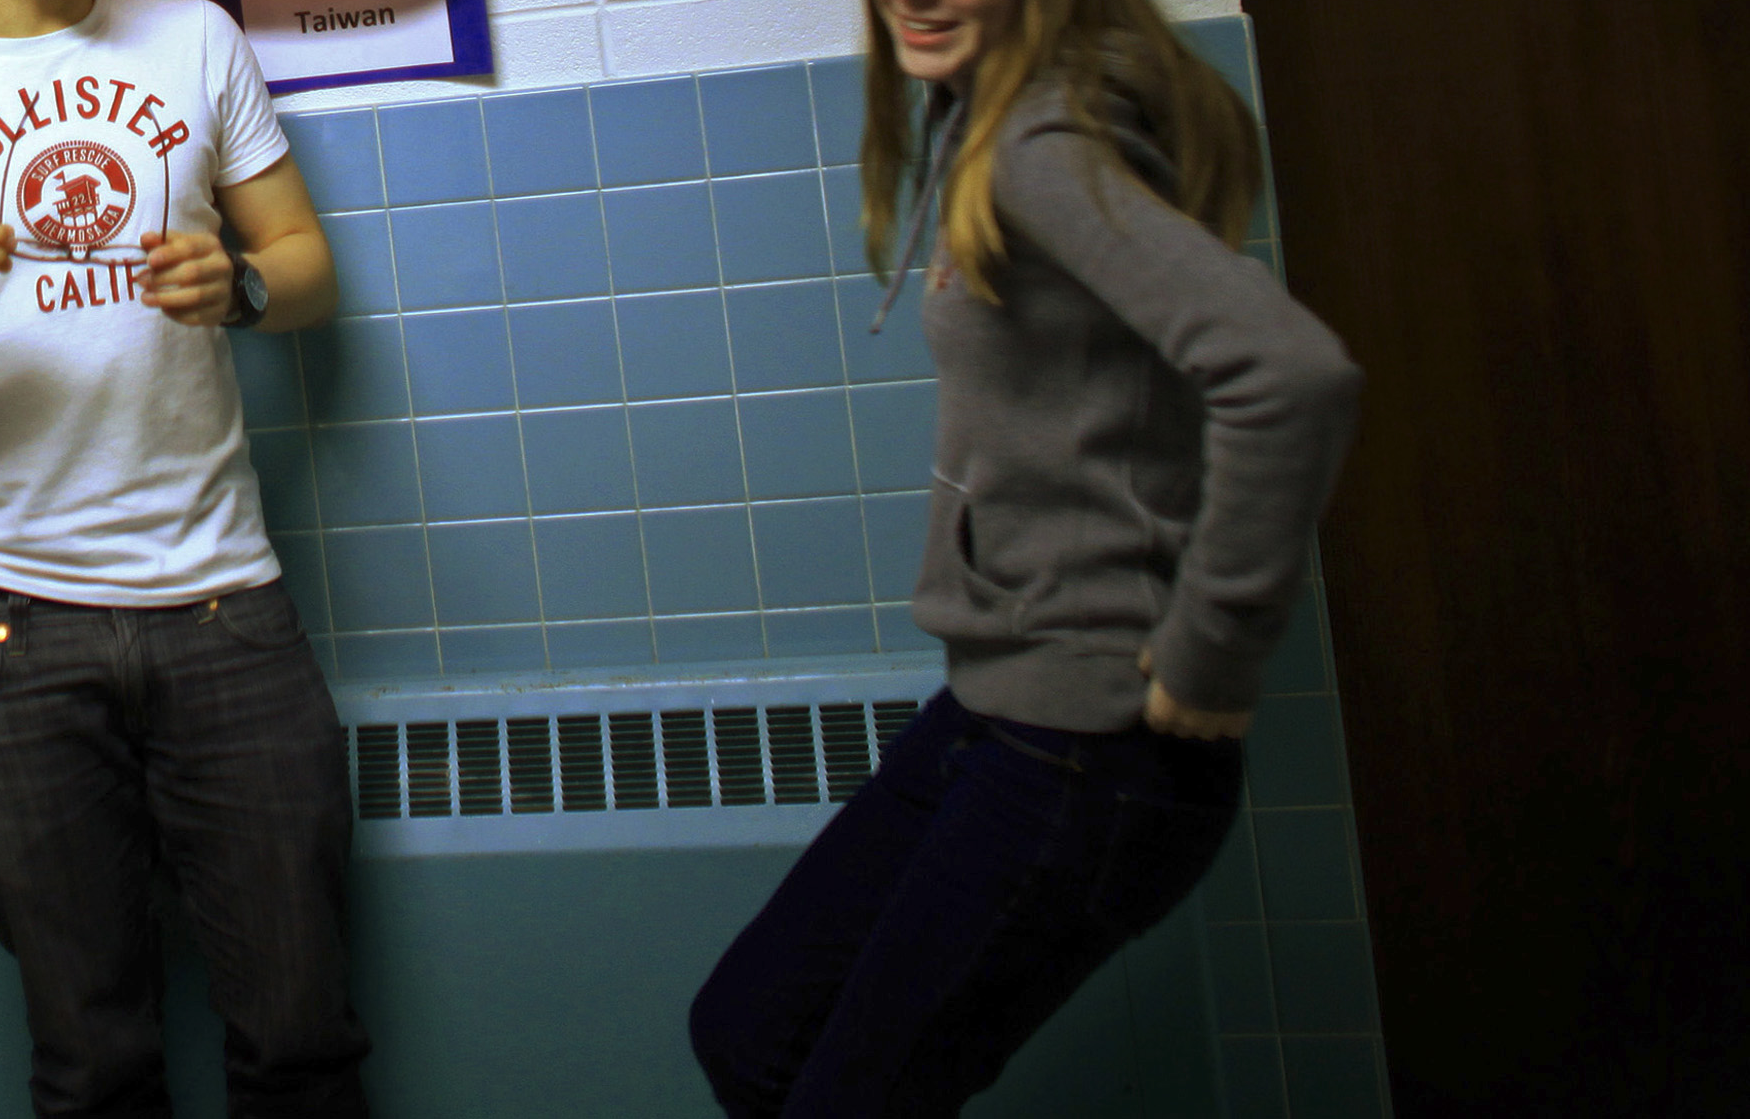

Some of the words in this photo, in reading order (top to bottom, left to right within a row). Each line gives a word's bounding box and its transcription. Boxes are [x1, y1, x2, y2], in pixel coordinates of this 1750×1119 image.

[293, 6, 396, 34] Taiwan
[31, 153, 60, 182] SURF
[63, 149, 111, 169] RESCUE
[71, 193, 87, 206] 22
[102, 209, 120, 226] CA
